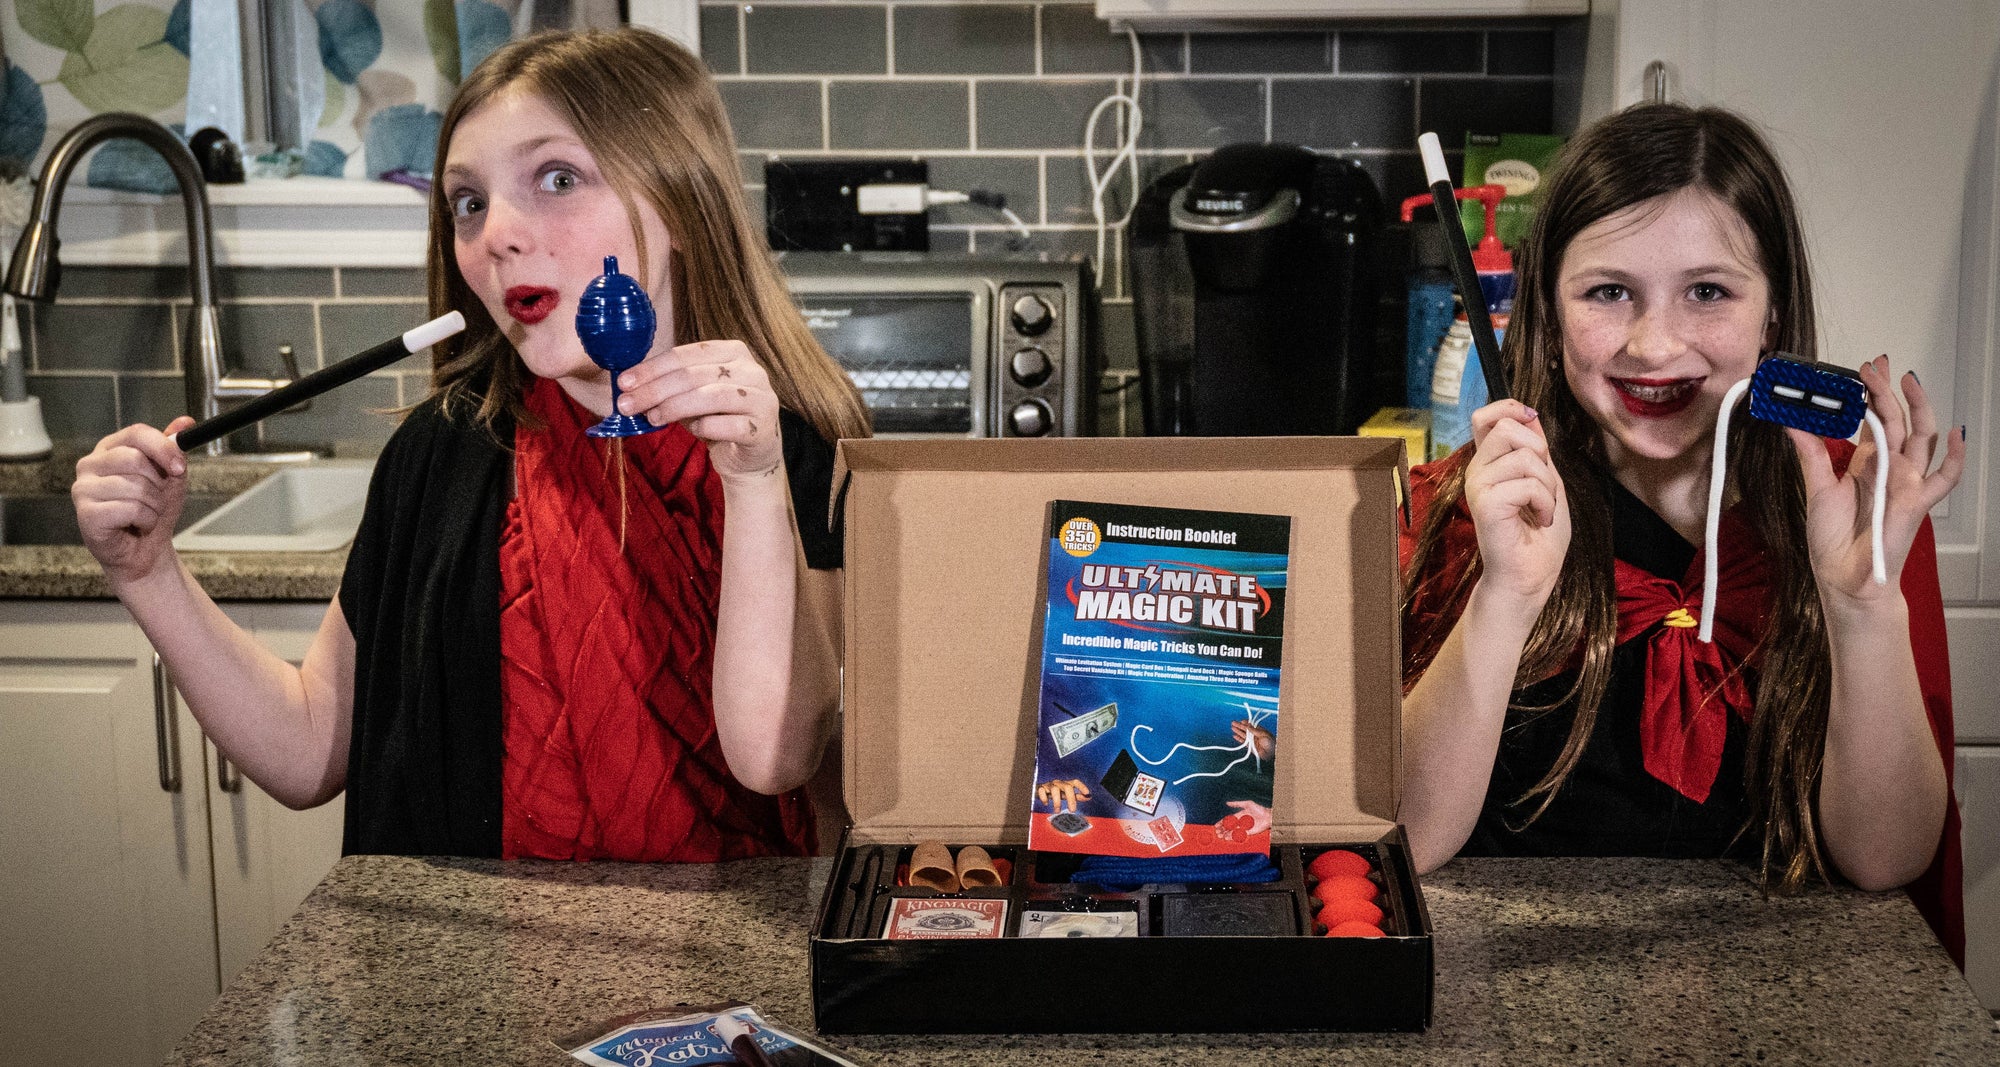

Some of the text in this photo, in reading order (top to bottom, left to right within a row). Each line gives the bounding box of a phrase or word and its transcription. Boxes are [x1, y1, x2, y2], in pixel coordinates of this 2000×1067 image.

[1489, 169, 1536, 181] TWININGS
[1197, 200, 1243, 210] KEURIG
[1069, 521, 1093, 531] OVER
[1106, 522, 1237, 545] Instruction Booklet
[1065, 529, 1096, 544] 350
[1065, 542, 1096, 552] TRICKS!
[1075, 590, 1259, 632] MAGIC KIT
[1062, 633, 1263, 659] Incredible Magic Tricks You Can Do!
[1091, 667, 1117, 675] Vanishing
[1128, 669, 1144, 677] Magic
[1154, 671, 1184, 679] Penetration
[1187, 673, 1209, 682] Amazing
[1238, 677, 1259, 685] Mystery
[1125, 662, 1142, 670] Magic
[1218, 669, 1234, 677] Magic
[1234, 670, 1254, 678] Sponge
[905, 900, 994, 914] KINGMAGIC
[608, 1030, 706, 1057] Magical
[622, 1033, 776, 1067] Katria
